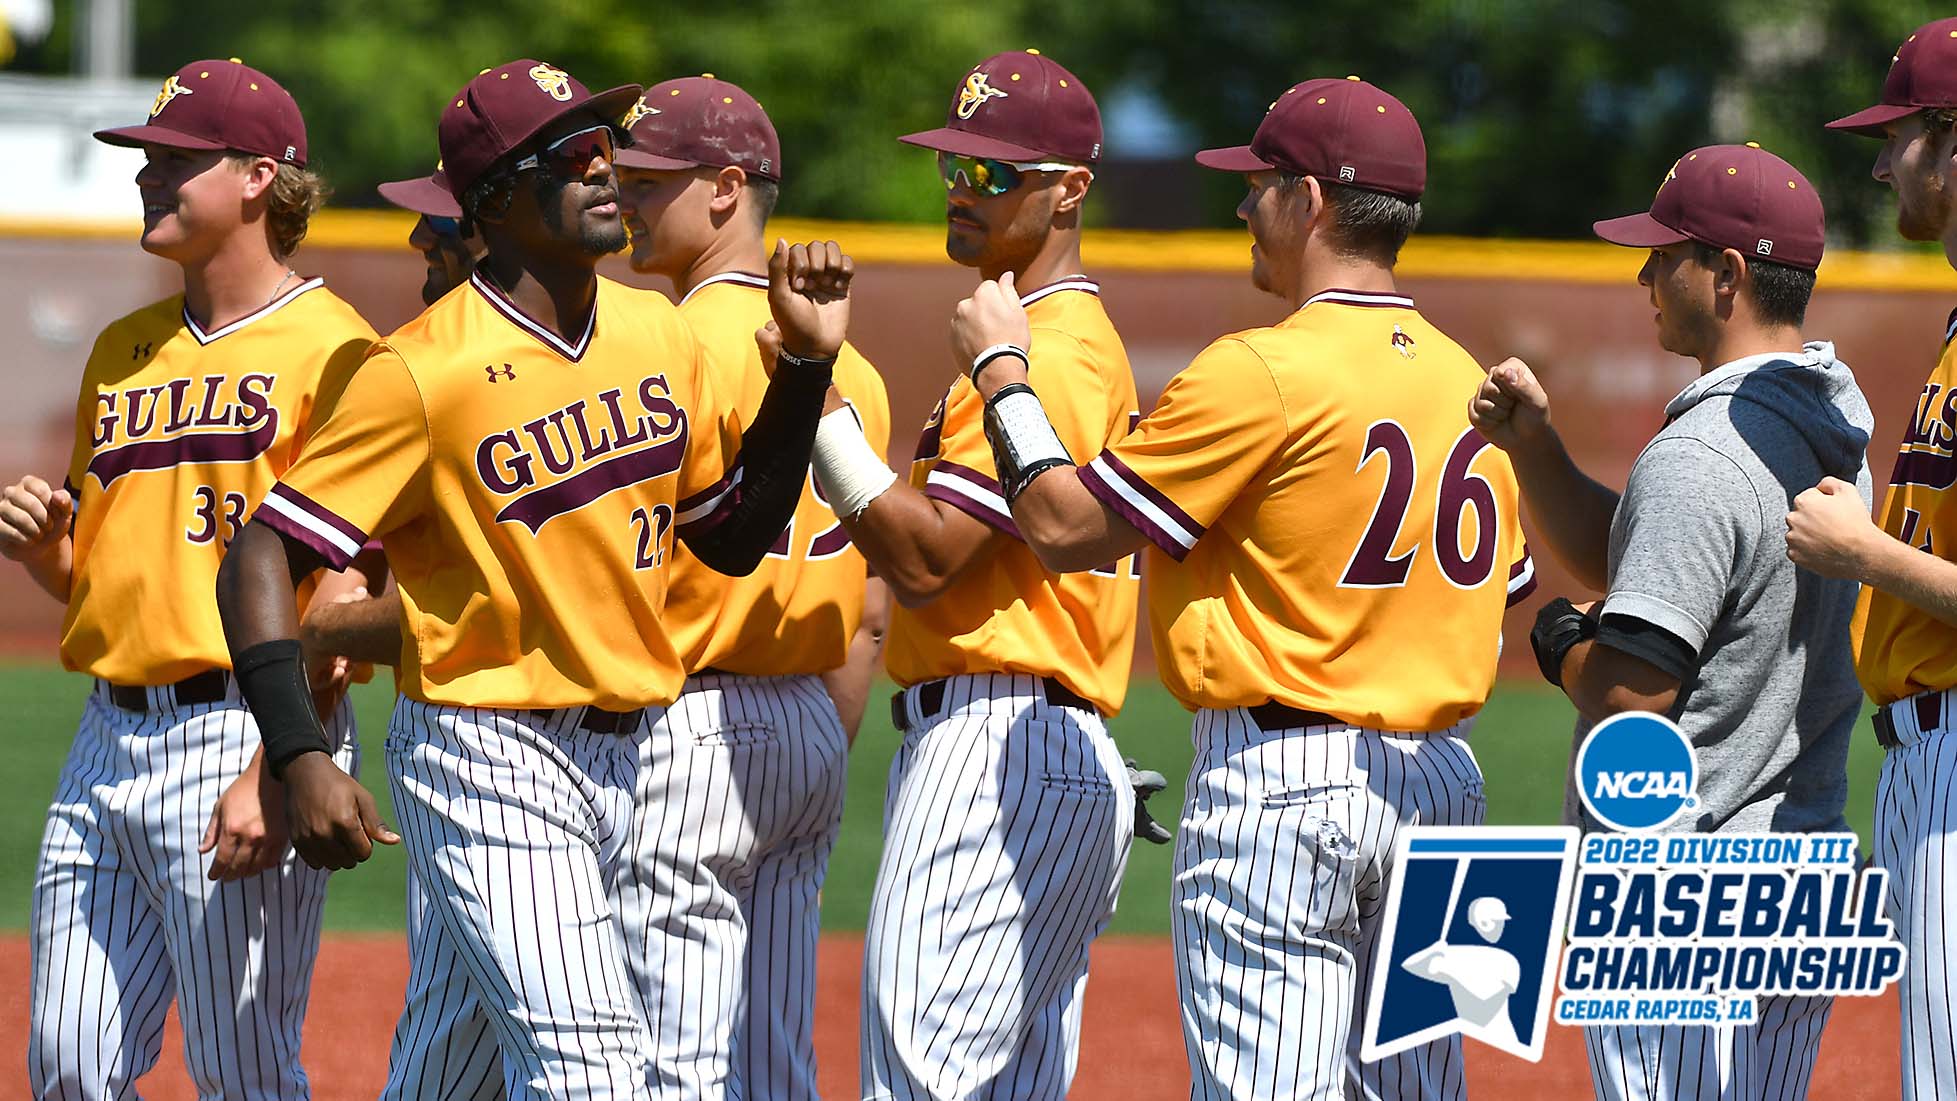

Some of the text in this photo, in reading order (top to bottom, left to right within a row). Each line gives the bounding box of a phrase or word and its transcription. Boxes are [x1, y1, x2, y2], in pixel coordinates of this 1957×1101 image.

[91, 373, 278, 449] GULLS
[475, 373, 681, 495] GULLS
[185, 484, 248, 548] 33
[629, 503, 673, 572] 22
[1336, 418, 1500, 591] 26
